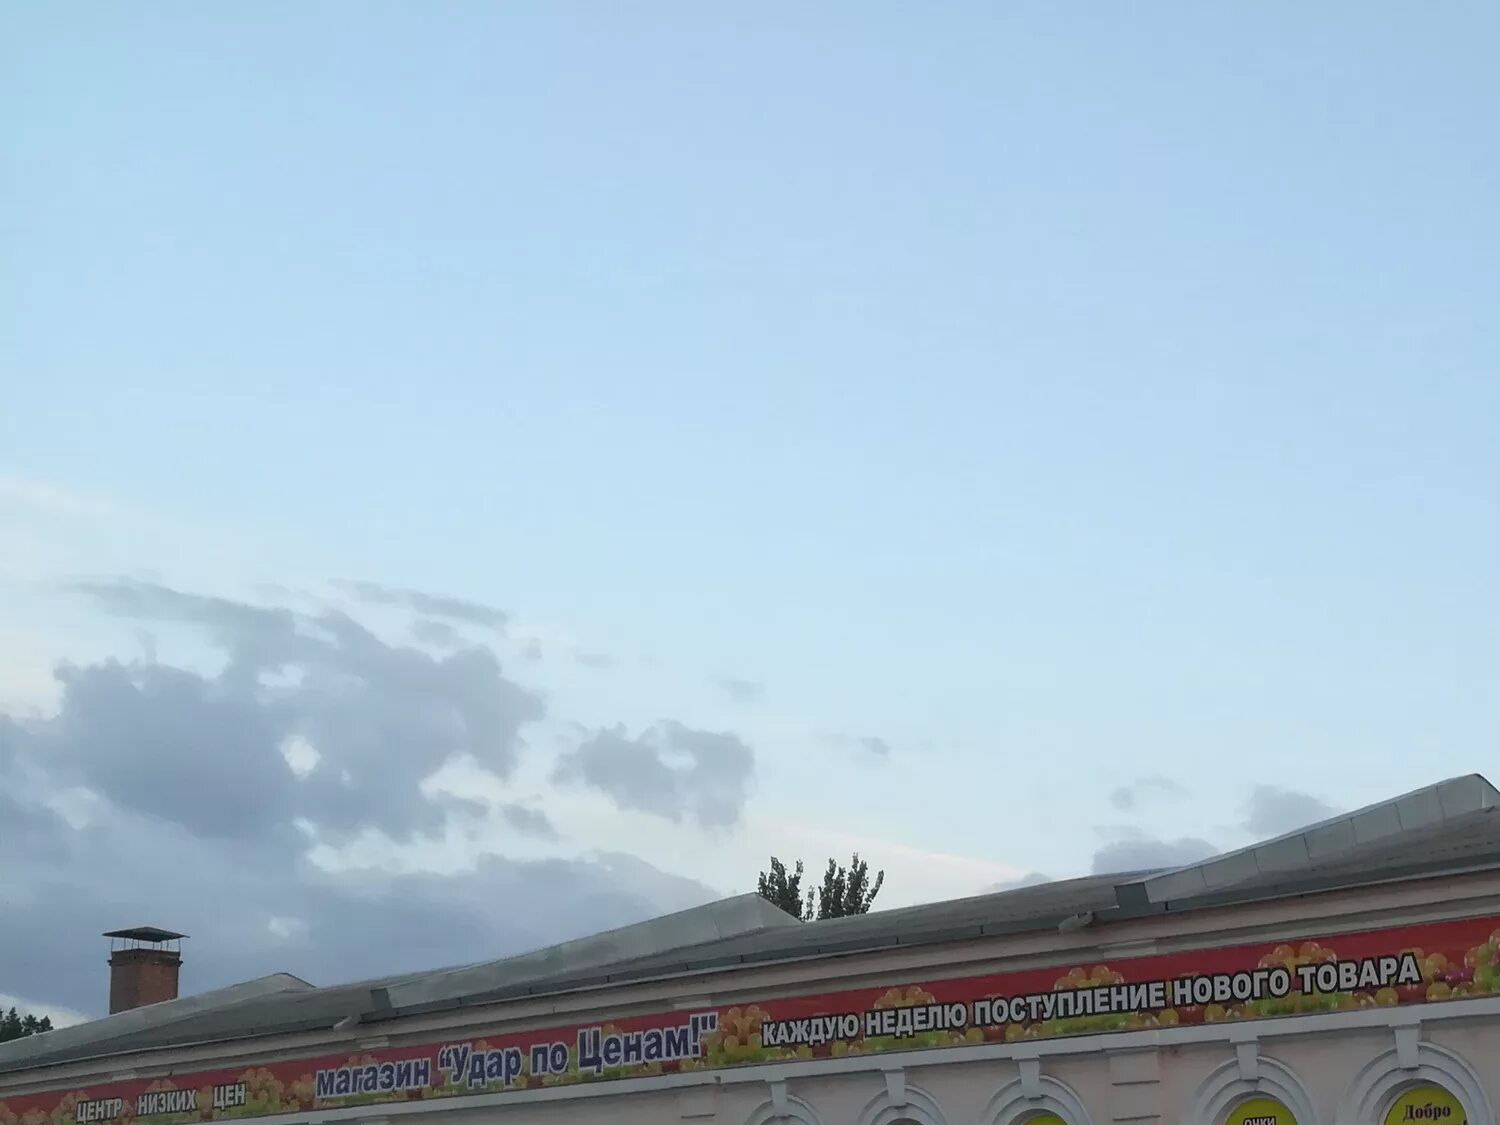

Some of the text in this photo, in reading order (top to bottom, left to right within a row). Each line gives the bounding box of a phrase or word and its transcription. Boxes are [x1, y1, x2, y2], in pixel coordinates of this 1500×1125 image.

[762, 954, 1421, 1047] КАЖДУЮ НЕДЕЛЮ ПОСТУПЛЕНИЕ НОВОГО ТОВАРА
[316, 1058, 430, 1097] магазин
[531, 1042, 569, 1075] по
[76, 1081, 246, 1125] ЦЕНТР НИЗКИХ ЦЕН
[1403, 1103, 1451, 1122] Добро
